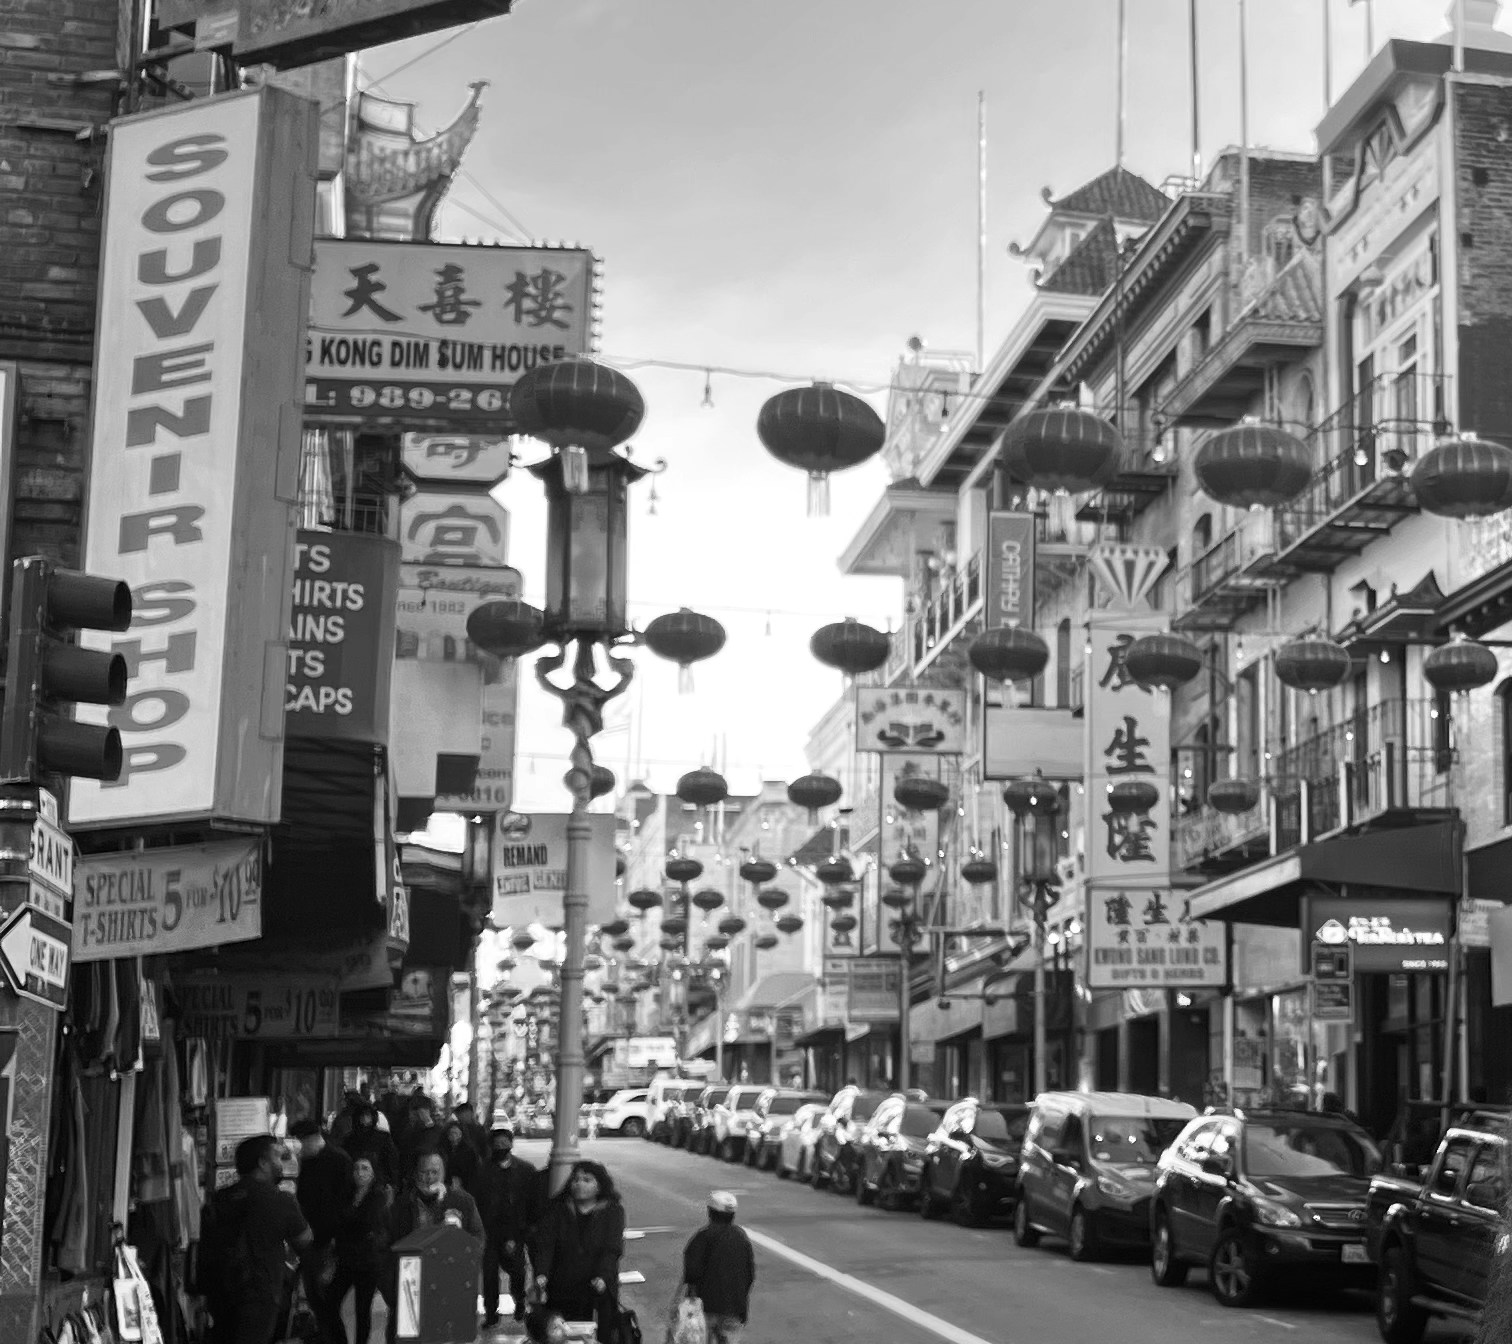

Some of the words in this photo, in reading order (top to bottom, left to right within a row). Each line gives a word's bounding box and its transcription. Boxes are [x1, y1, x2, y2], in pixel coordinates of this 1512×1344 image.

[118, 134, 229, 554] SOUVENIR
[320, 338, 382, 368] KONG
[390, 339, 430, 369] DIM
[437, 339, 483, 370] SUM
[490, 343, 566, 372] HOUSE
[305, 383, 336, 407] L:
[293, 579, 364, 612] HIRTS
[100, 580, 197, 789] SHOP
[86, 867, 154, 906] SPECIAL
[161, 869, 182, 931] 5
[186, 886, 208, 908] FOR
[81, 907, 158, 947] T-SHIRTS
[30, 936, 47, 971] ONE
[48, 943, 65, 979] WAY
[244, 991, 262, 1034] 5
